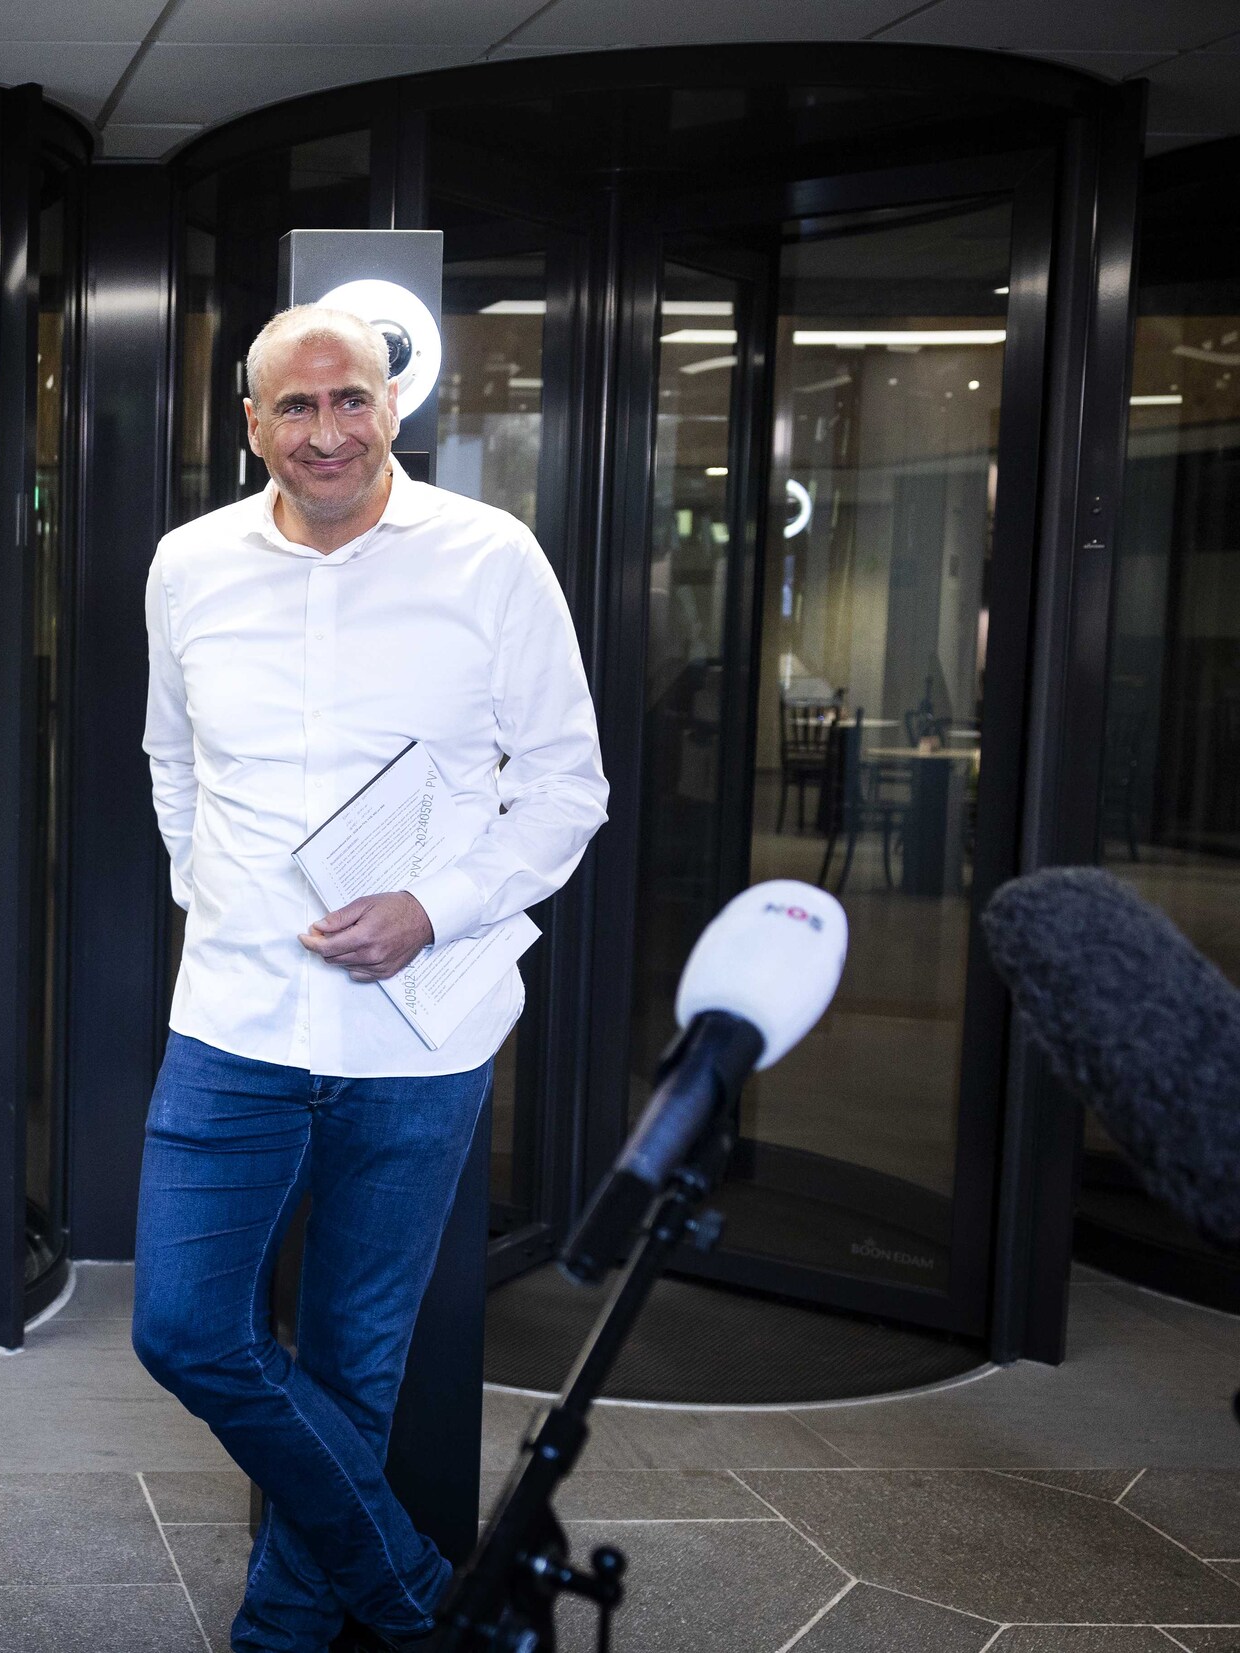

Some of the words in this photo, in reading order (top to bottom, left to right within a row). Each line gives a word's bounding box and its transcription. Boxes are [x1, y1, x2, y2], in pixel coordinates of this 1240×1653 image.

[414, 793, 434, 848] 20240502
[410, 855, 422, 878] PVV
[893, 1251, 934, 1270] EDAM
